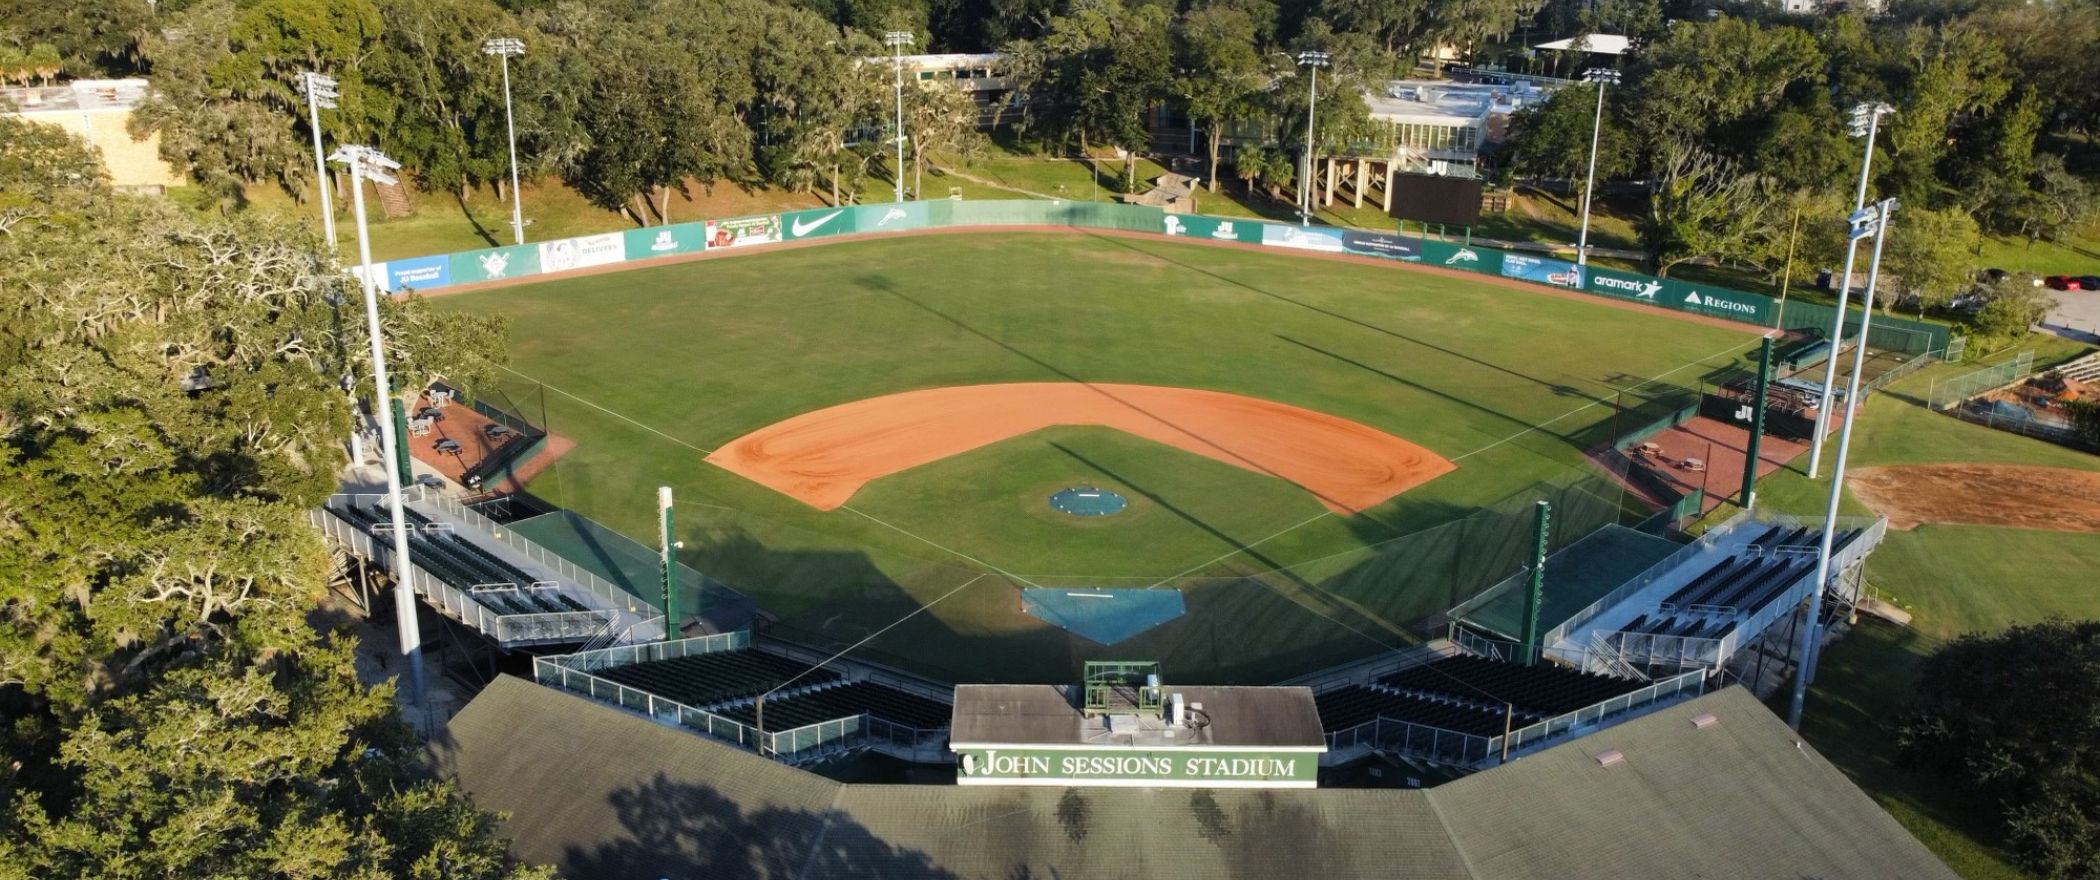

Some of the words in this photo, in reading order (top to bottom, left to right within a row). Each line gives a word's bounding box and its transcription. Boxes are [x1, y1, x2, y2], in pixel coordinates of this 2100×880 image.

[1427, 160, 1448, 176] JU
[1594, 276, 1642, 293] aramark
[1703, 295, 1757, 314] REGIONS
[981, 750, 1051, 776] JOHN
[1061, 756, 1172, 775] SESSIONS
[1186, 757, 1296, 777] STADIUM
